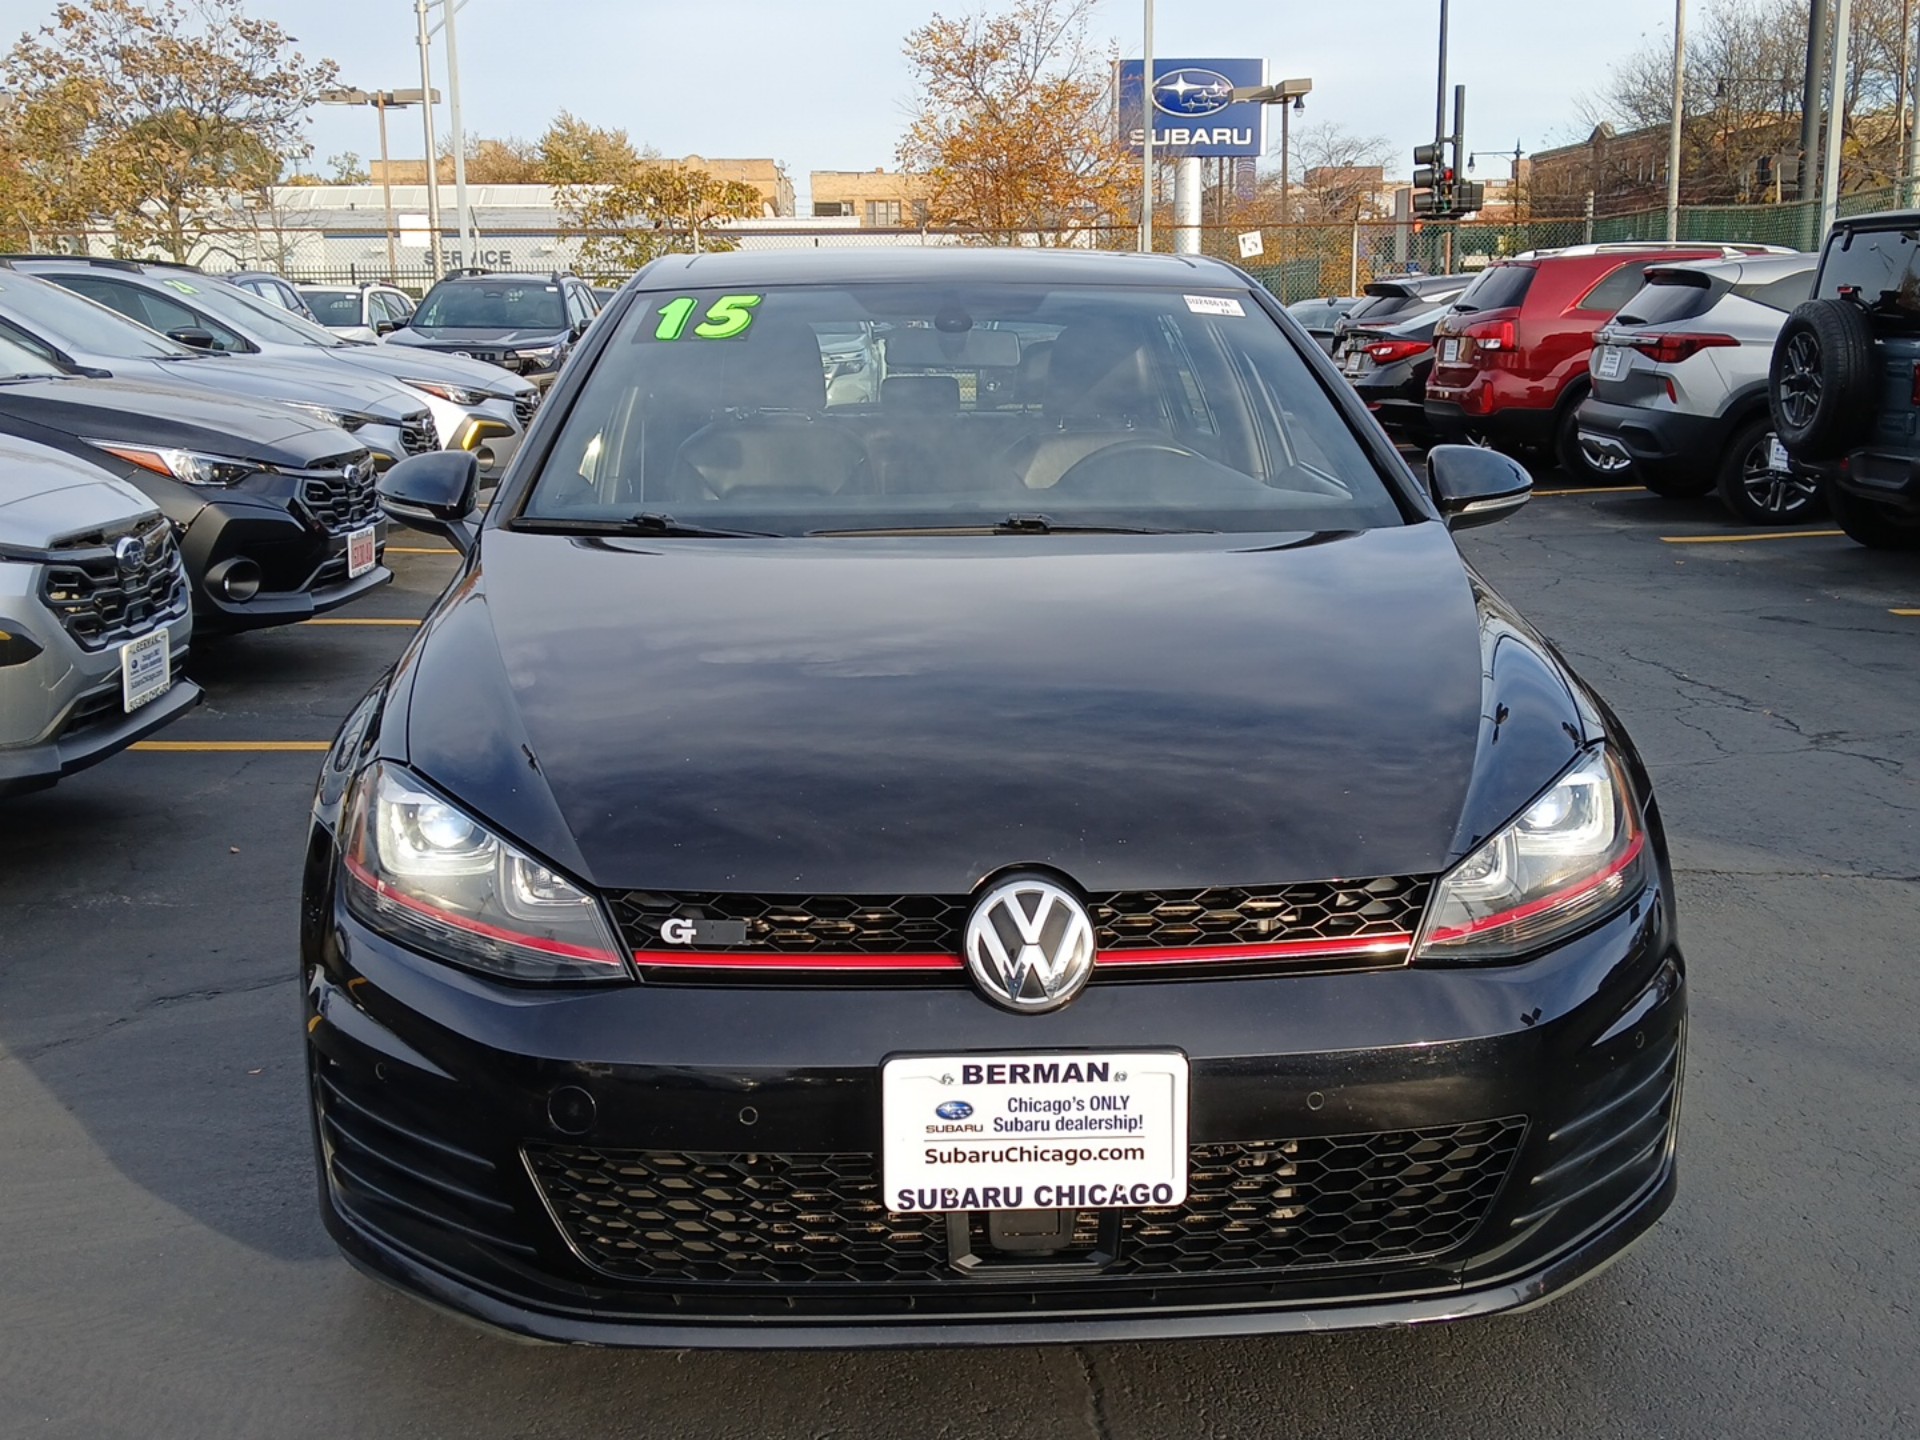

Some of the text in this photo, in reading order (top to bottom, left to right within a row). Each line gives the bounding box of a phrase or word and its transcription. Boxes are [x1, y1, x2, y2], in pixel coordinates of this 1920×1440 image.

[1129, 128, 1252, 146] SUBARU
[655, 293, 762, 341] 15
[660, 918, 697, 945] G
[962, 1062, 1109, 1085] BERMAN
[1007, 1095, 1130, 1116] Chicago's ONLY
[925, 1124, 984, 1134] SUBARU
[993, 1114, 1143, 1134] Subaru dealership!
[925, 1145, 1145, 1166] SubaruChicago.com
[897, 1182, 1173, 1211] SUBARU CHICAGO
